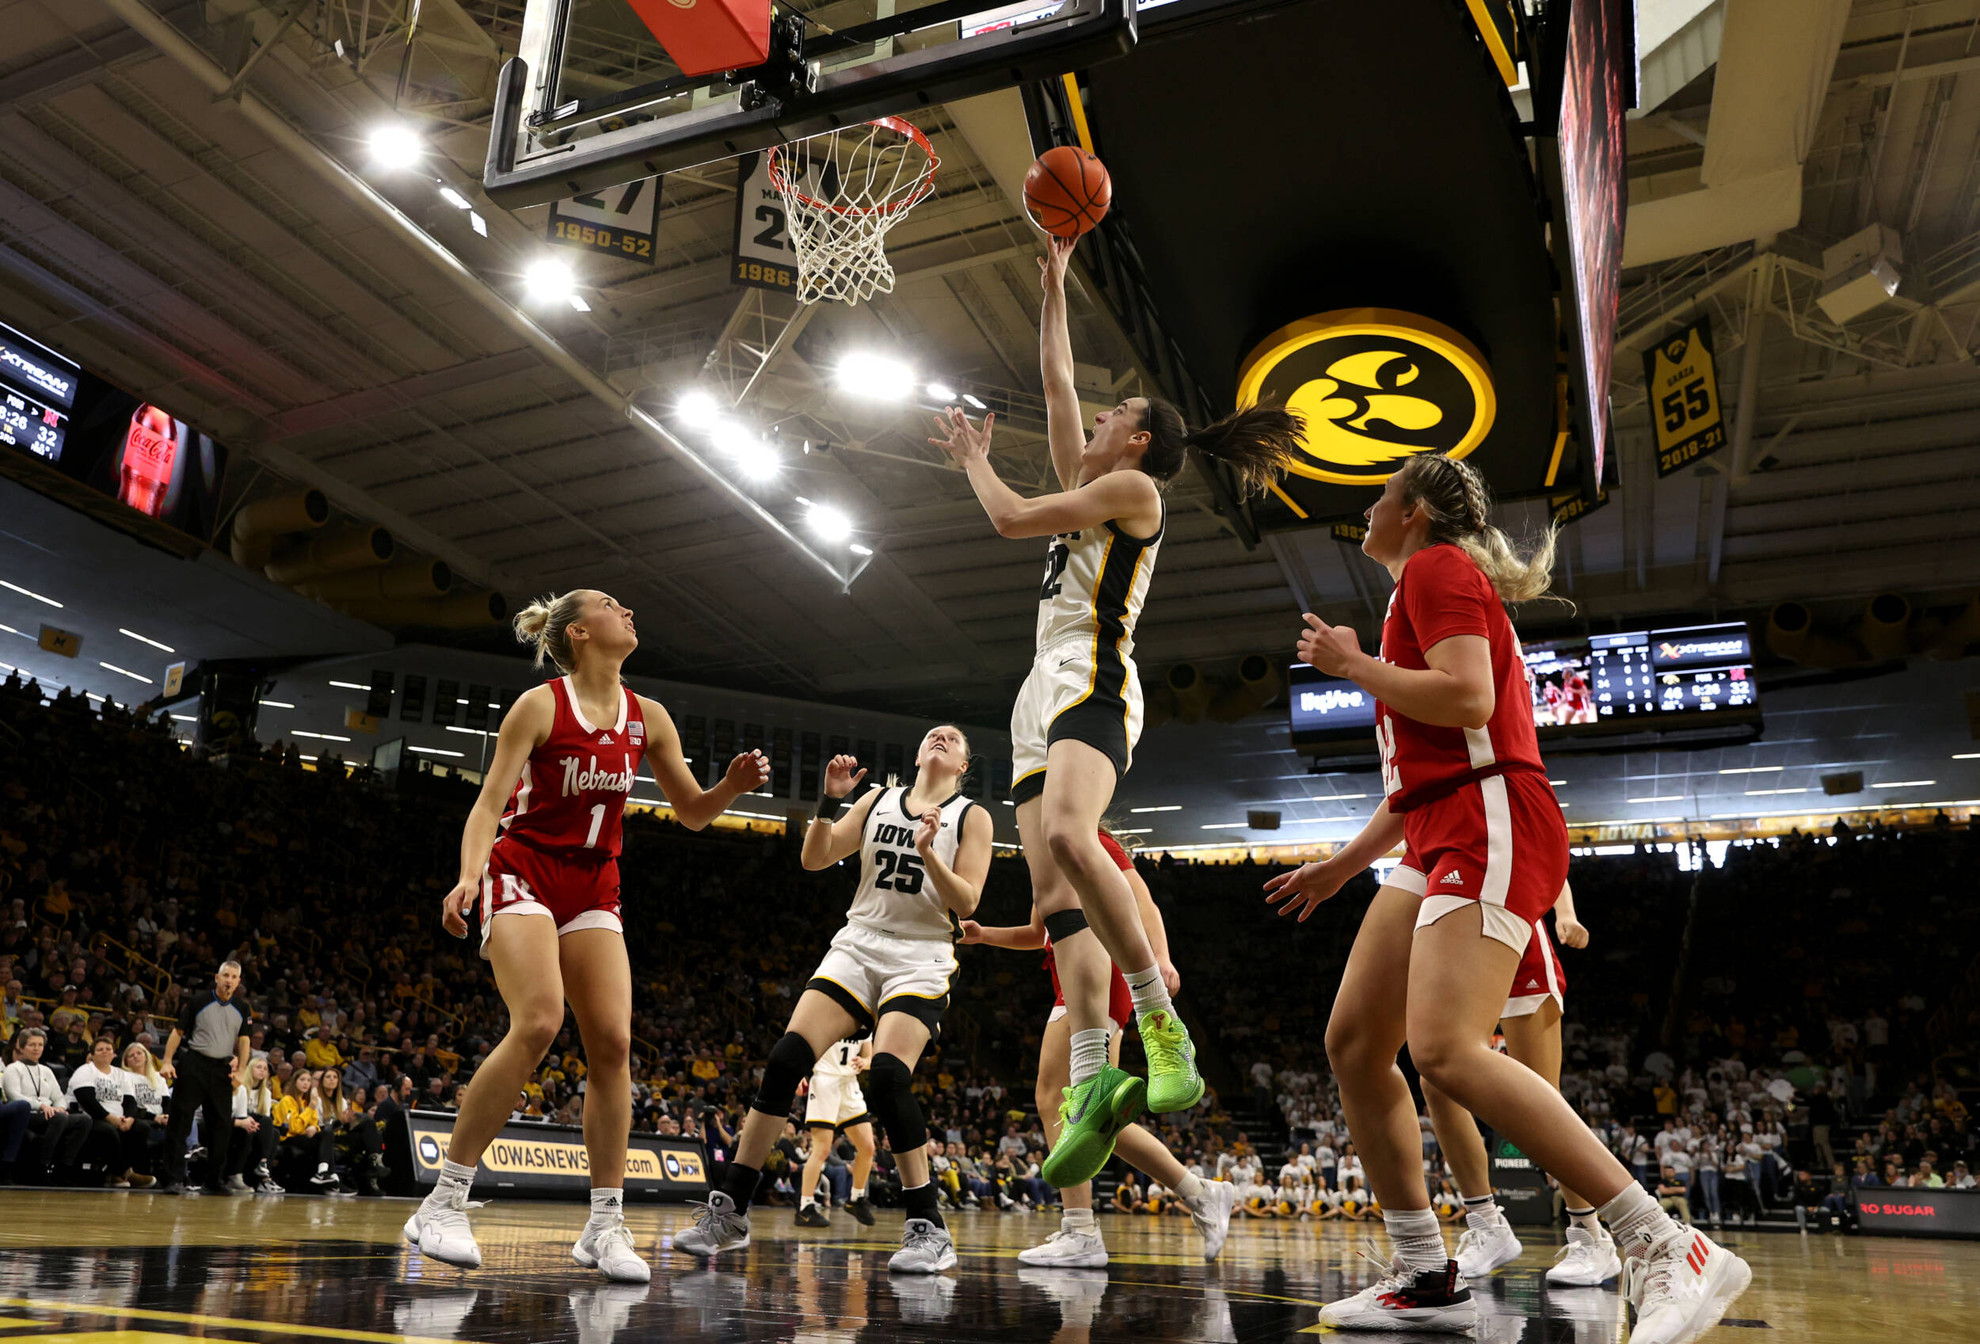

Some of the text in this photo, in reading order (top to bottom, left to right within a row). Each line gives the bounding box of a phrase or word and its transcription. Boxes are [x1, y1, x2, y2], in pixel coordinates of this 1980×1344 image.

[555, 221, 651, 257] 1950-52
[1666, 365, 1695, 387] GARZA
[1662, 376, 1710, 432] 55
[37, 426, 58, 447] 32
[1661, 428, 1722, 470] 2018-21
[1335, 524, 1367, 540] 1982
[1730, 681, 1750, 694] 32
[559, 752, 636, 797] Nebrask
[583, 803, 606, 848] 1
[872, 823, 934, 850] IOW
[1598, 824, 1655, 841] IOWA
[874, 849, 926, 895] 25
[501, 873, 536, 902] N
[840, 1046, 849, 1065] 1
[1882, 1204, 1935, 1216] SUGAR
